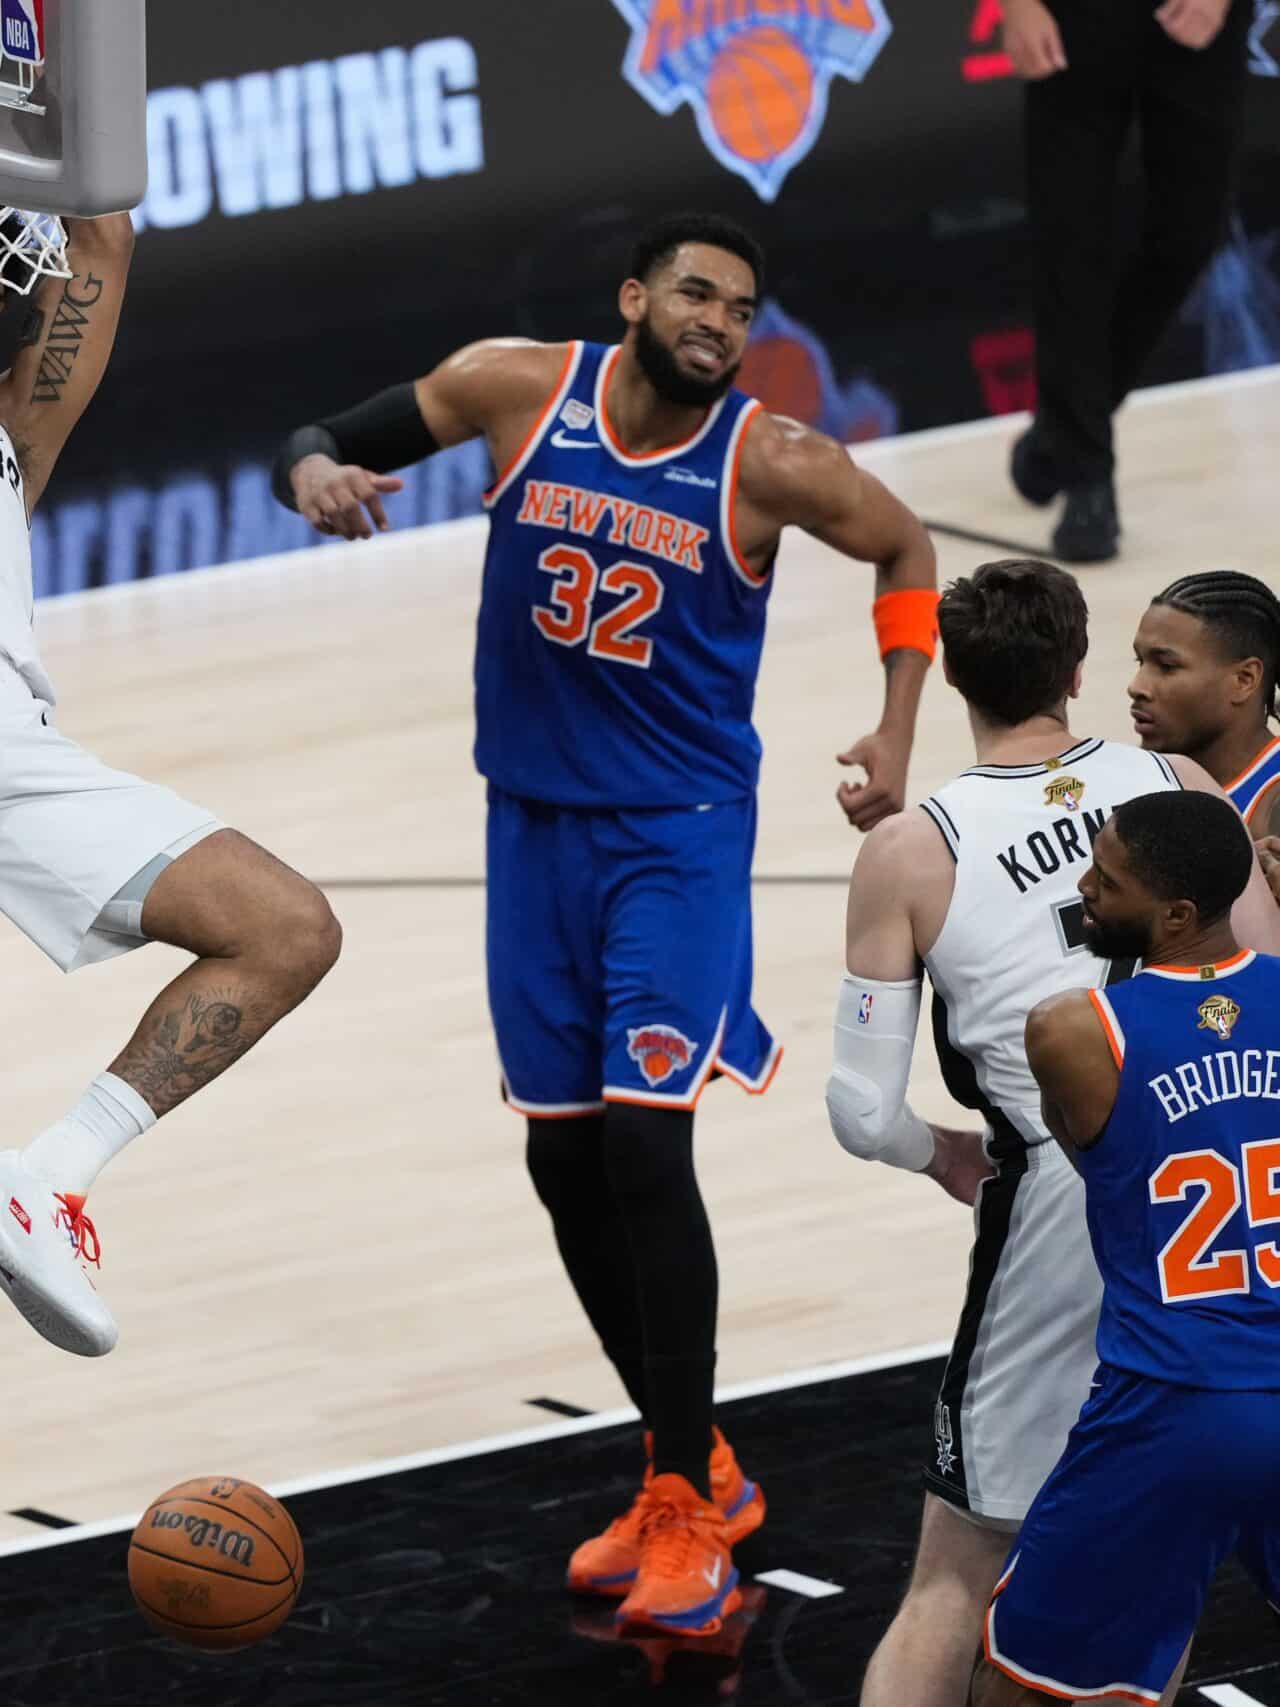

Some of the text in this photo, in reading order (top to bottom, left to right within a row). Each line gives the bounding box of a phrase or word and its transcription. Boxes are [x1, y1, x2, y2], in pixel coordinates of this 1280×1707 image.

[6, 16, 30, 51] NBA
[130, 36, 485, 236] OWING
[31, 272, 103, 406] WAWG
[517, 480, 608, 537] NEW
[608, 496, 710, 575] YORK
[532, 543, 664, 669] 32
[1044, 777, 1085, 806] Finals
[996, 805, 1118, 894] KORN
[151, 1509, 255, 1567] Wilson
